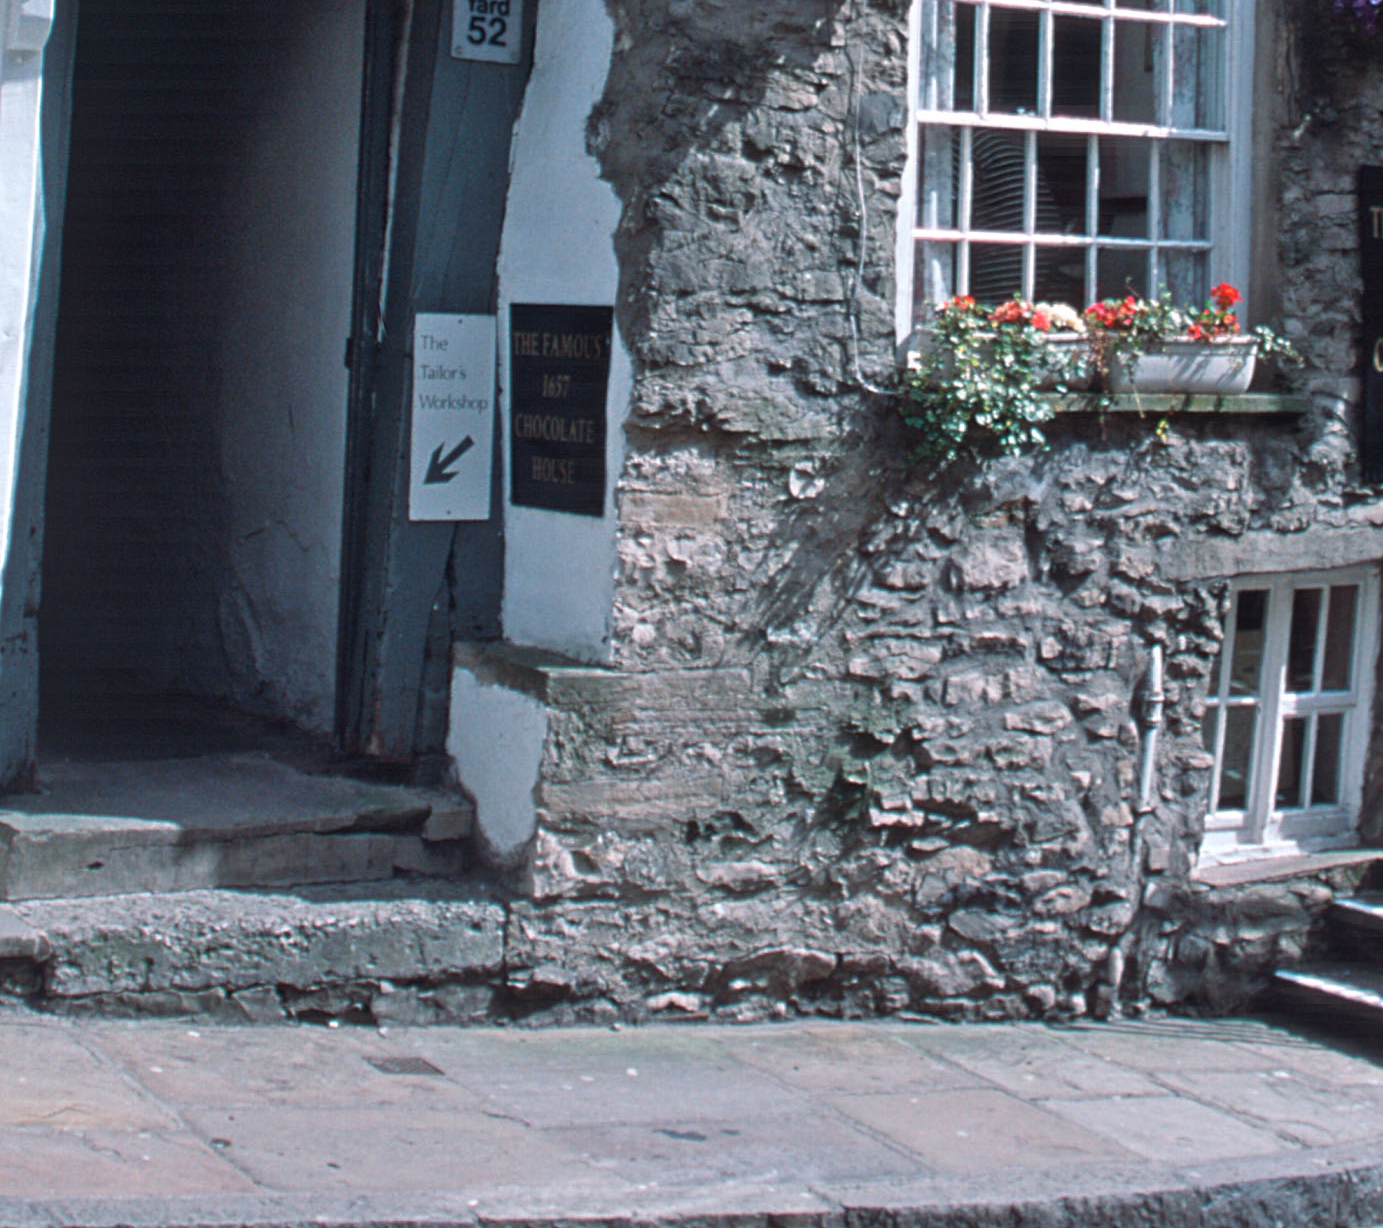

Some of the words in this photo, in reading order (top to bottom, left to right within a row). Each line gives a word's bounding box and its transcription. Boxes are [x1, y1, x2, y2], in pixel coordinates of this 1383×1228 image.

[467, 15, 507, 47] 52
[421, 335, 449, 352] The
[514, 332, 539, 356] THE
[543, 334, 602, 360] FAMOUS
[420, 364, 467, 381] Tailor's
[543, 374, 572, 398] 1657
[420, 394, 489, 416] Workshop
[515, 413, 594, 444] CHOCOLATE
[532, 455, 576, 485] HOUSE
